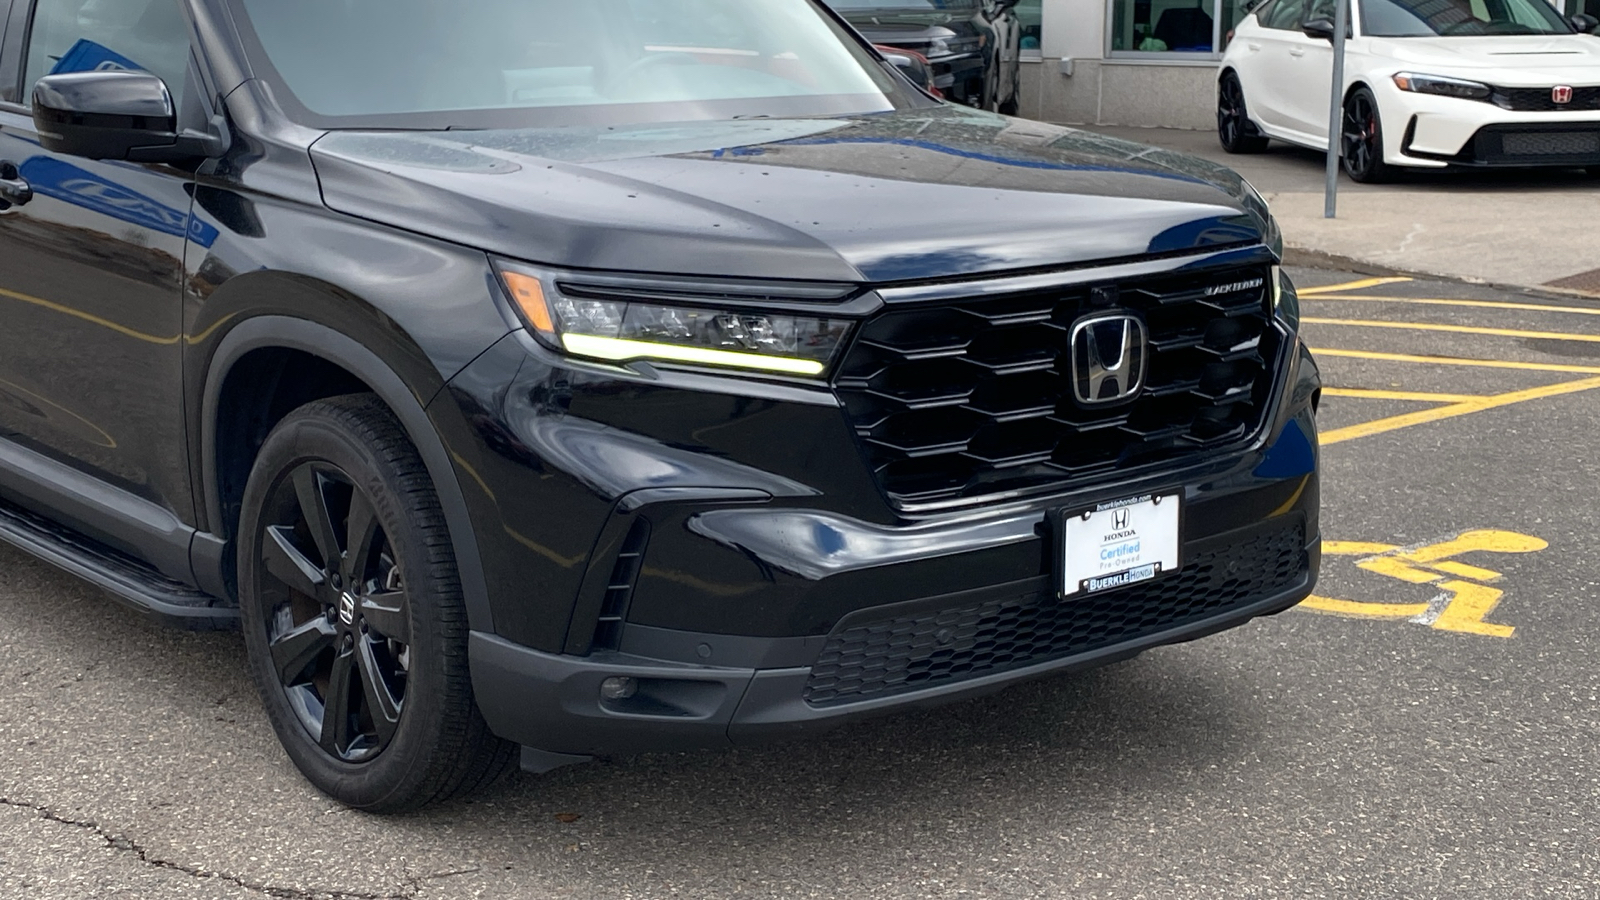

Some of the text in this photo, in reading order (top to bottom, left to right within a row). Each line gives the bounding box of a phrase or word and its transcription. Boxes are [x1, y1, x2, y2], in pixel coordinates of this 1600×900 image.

[1104, 529, 1136, 542] HONDA
[1100, 541, 1140, 561] Certified
[1099, 554, 1140, 570] Pre-Owned
